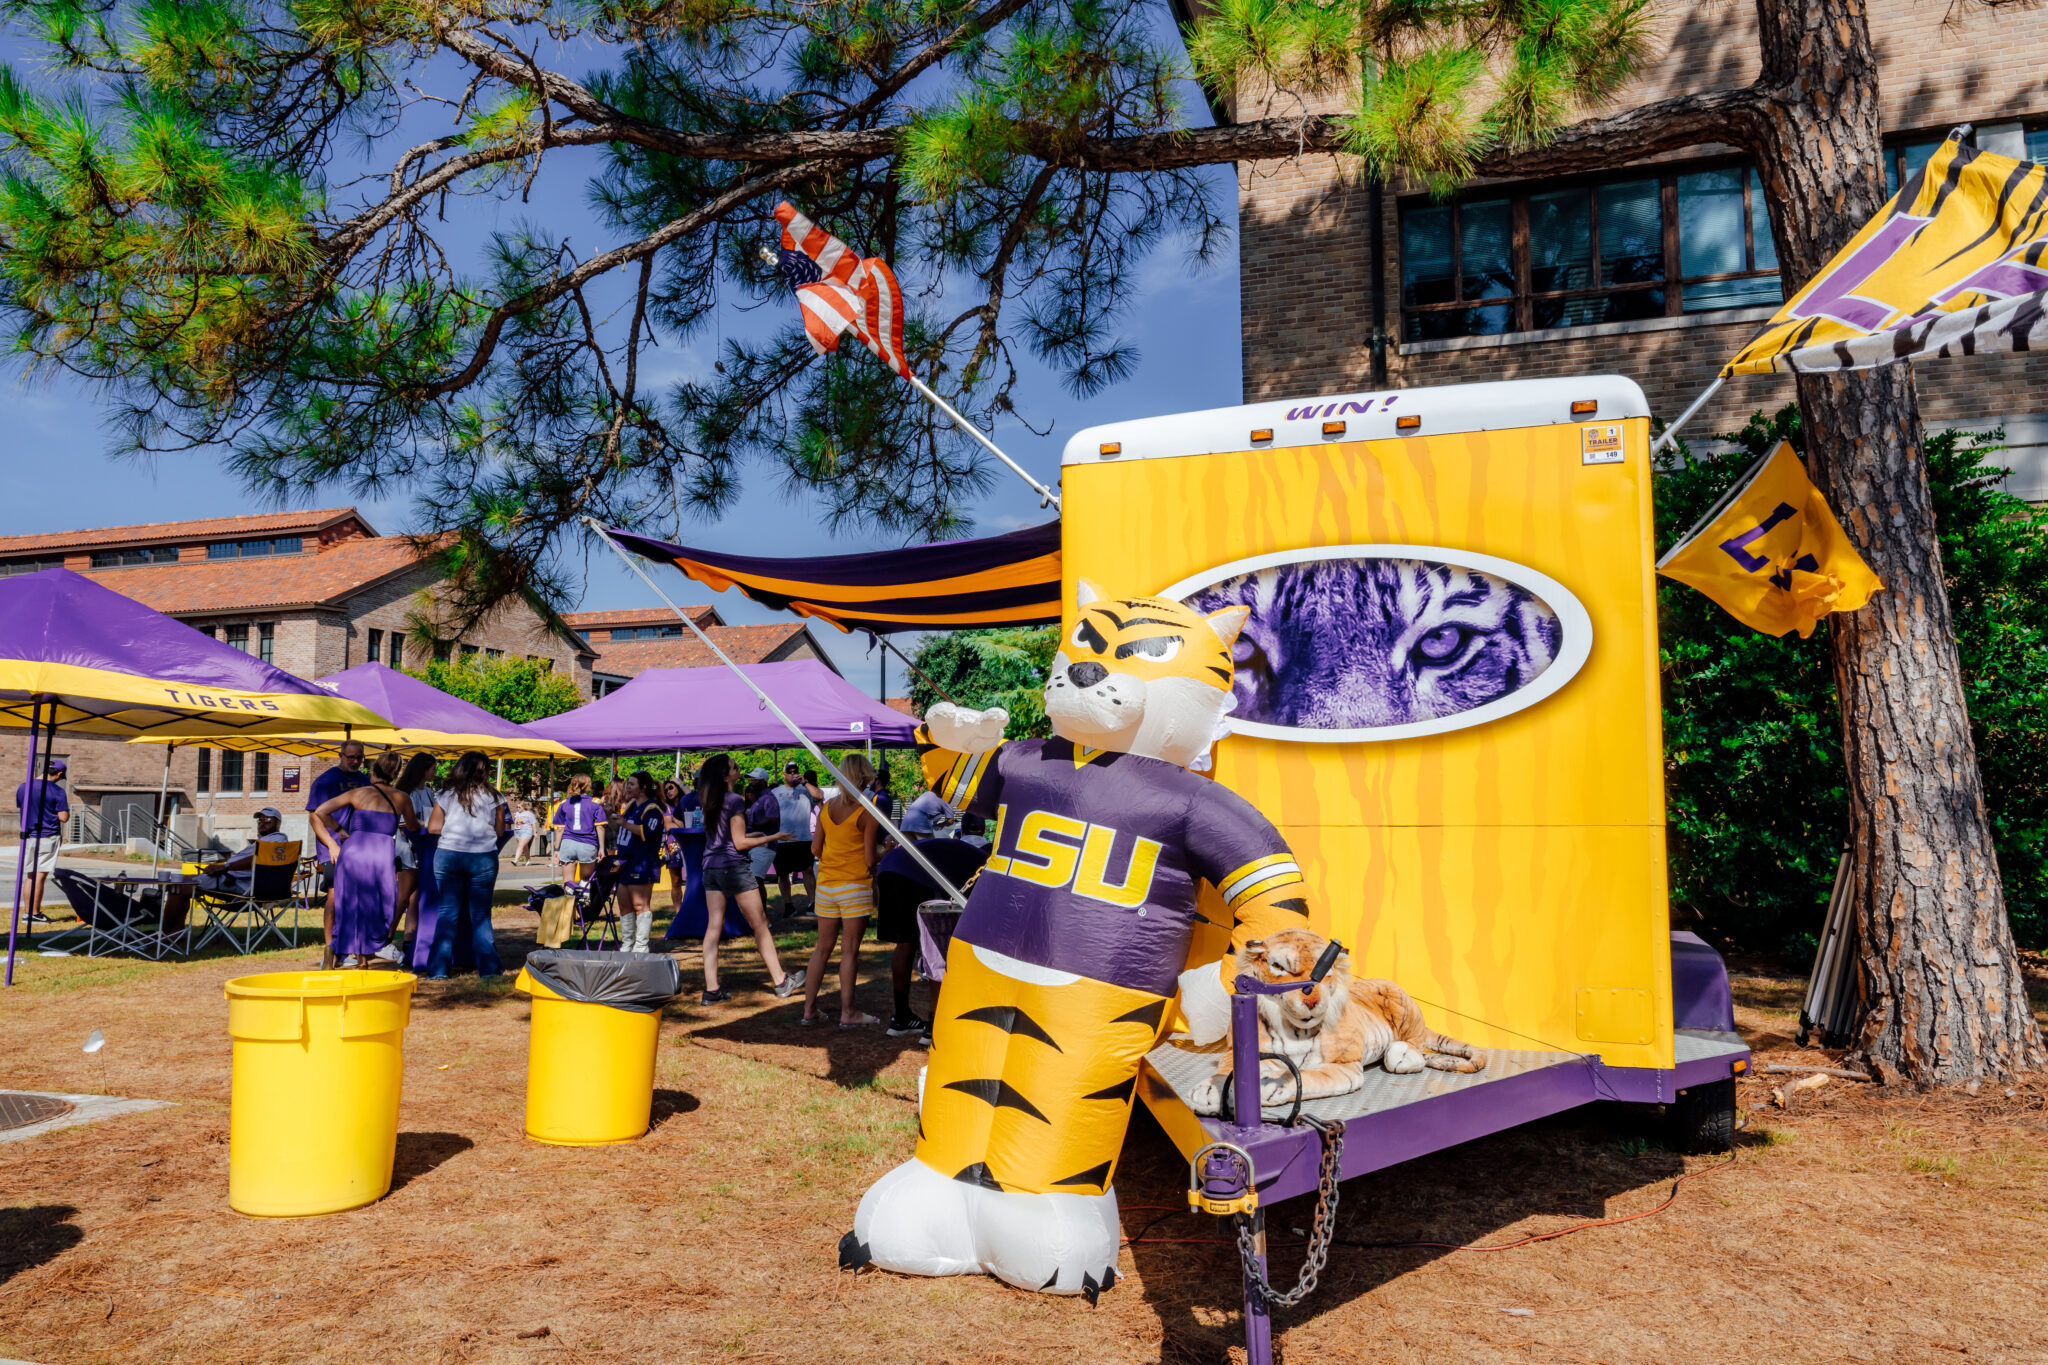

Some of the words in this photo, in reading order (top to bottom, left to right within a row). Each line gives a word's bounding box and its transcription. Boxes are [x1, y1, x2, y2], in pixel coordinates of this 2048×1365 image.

[1284, 396, 1399, 421] WIN!
[164, 689, 280, 711] TIGERS
[572, 802, 582, 831] 1
[984, 803, 1163, 909] LSU
